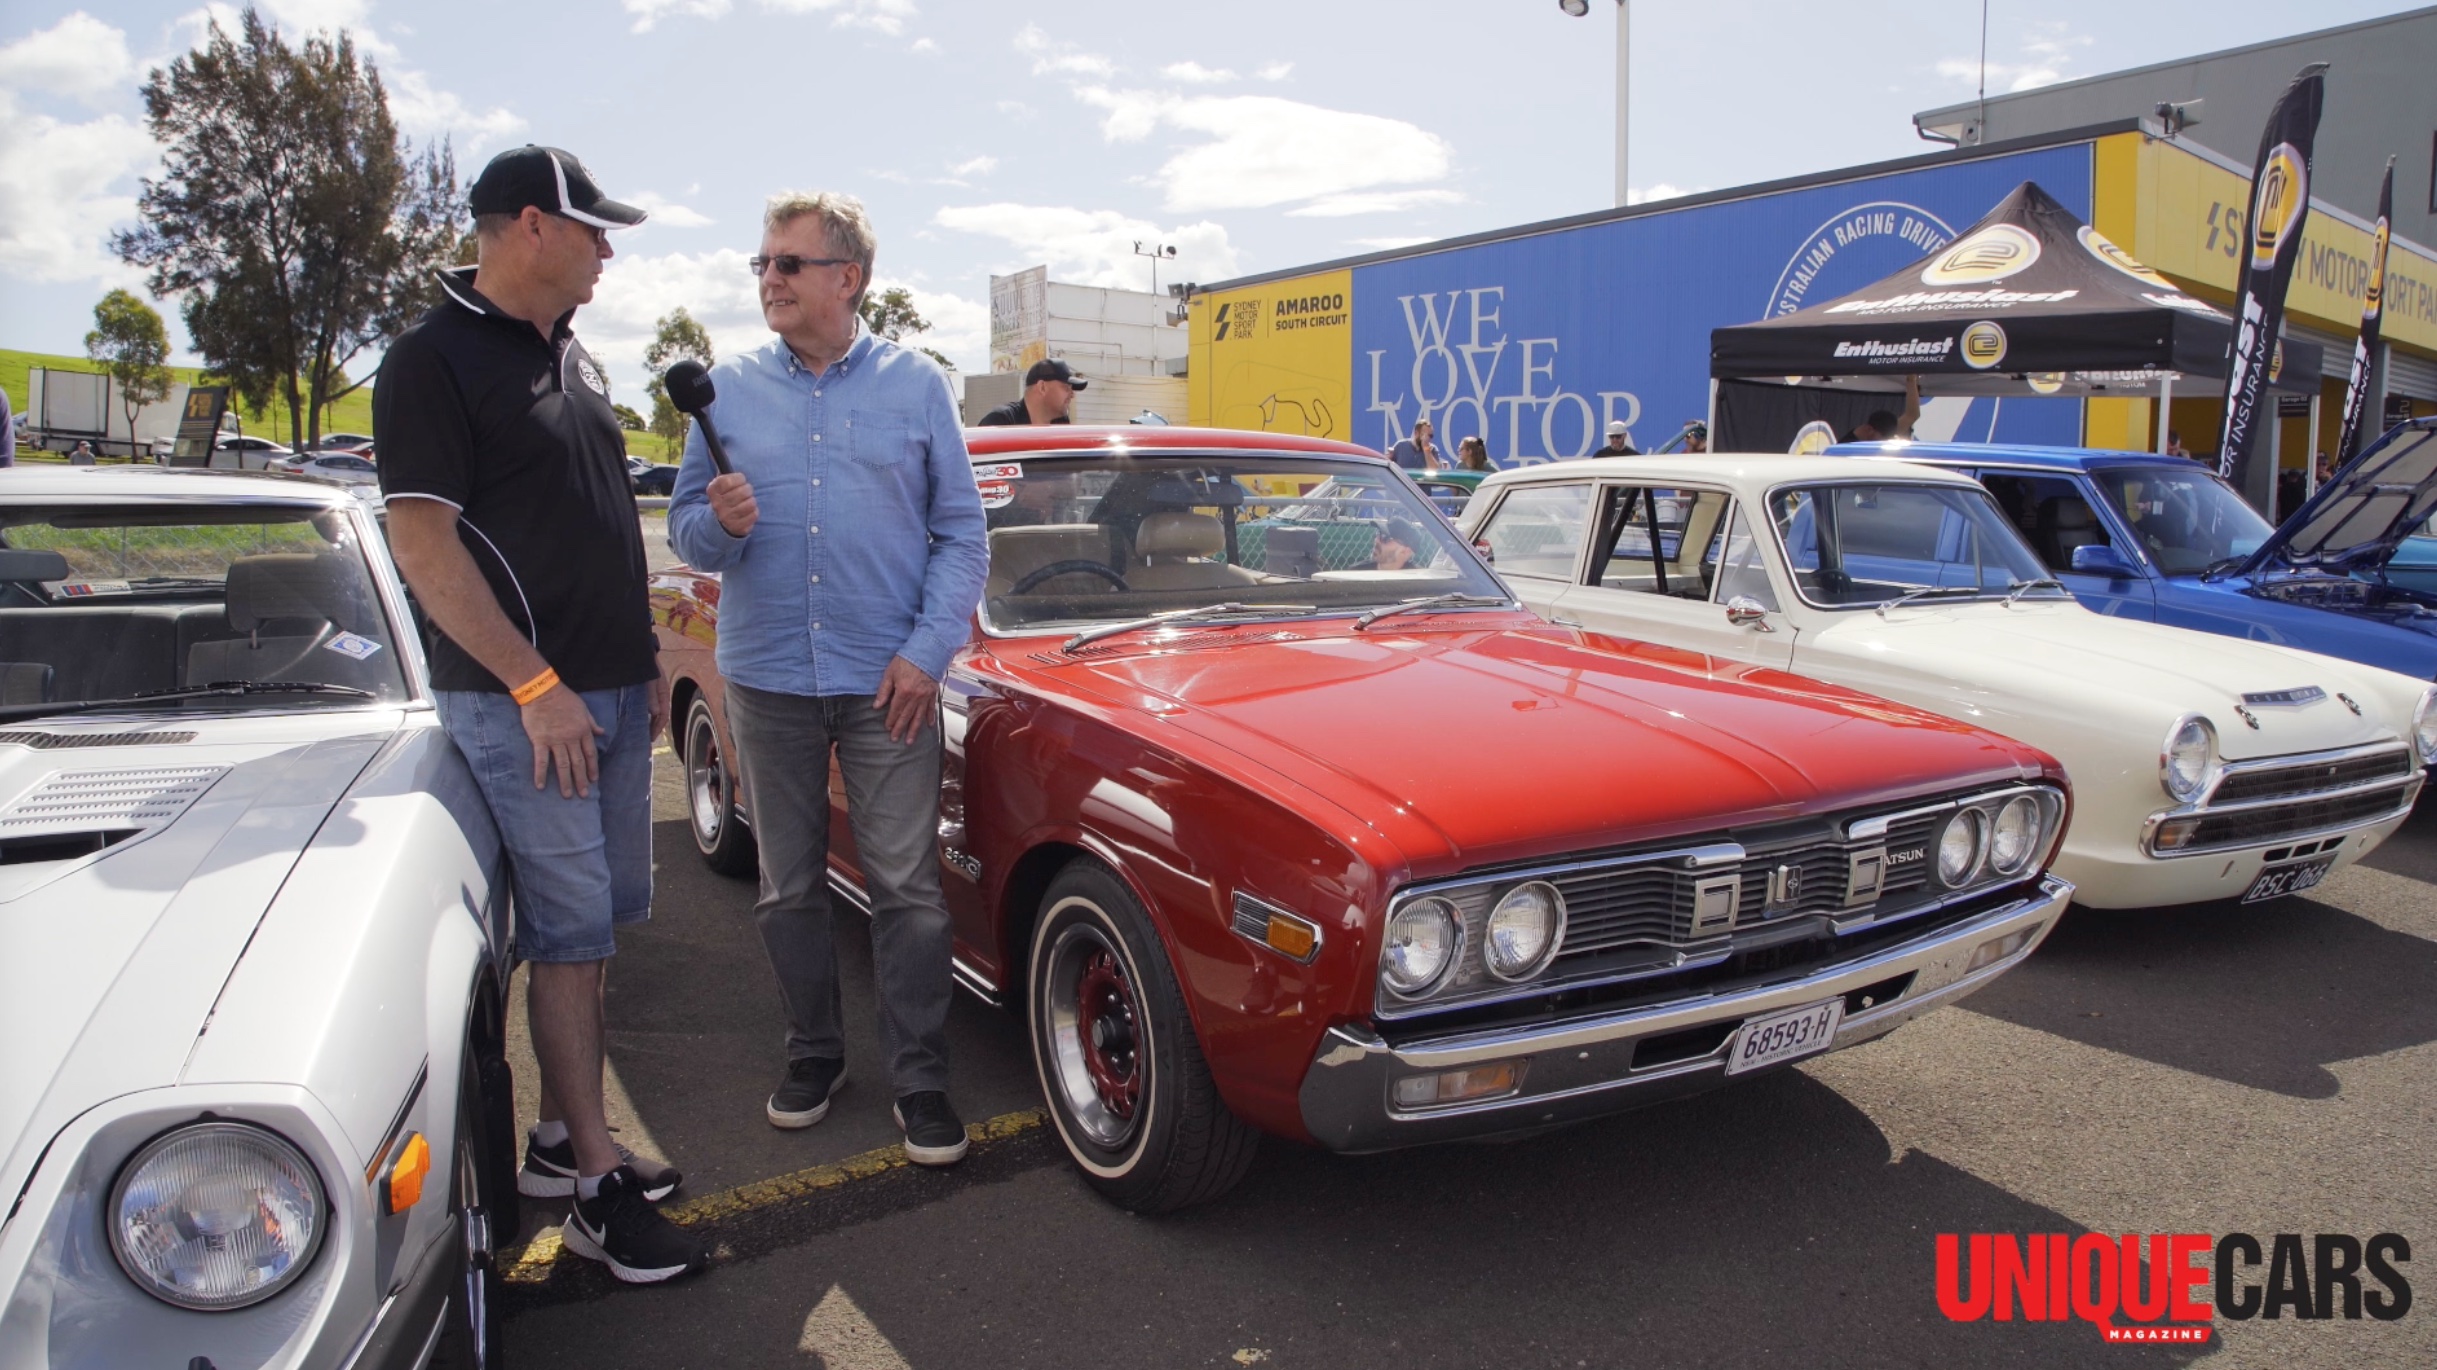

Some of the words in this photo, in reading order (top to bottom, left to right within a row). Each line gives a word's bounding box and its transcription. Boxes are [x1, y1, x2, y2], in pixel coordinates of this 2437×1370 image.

[1777, 239, 1835, 317] STRALIAN
[1834, 213, 1895, 247] RACING
[1899, 217, 1949, 255] DRIVE
[1233, 300, 1261, 311] SYDNEY
[1276, 294, 1343, 316] AMAROO
[1823, 289, 2079, 314] Enthusiast
[1856, 306, 1910, 315] MOTOR
[1917, 302, 2017, 312] INSURANCE
[1233, 310, 1258, 320] MOTOR
[1276, 318, 1307, 331] SOUTH
[1310, 314, 1347, 327] CIRCUIT
[1398, 286, 1507, 357] WE
[1233, 319, 1256, 330] SPORT
[1233, 330, 1253, 340] PARK
[1833, 337, 1954, 357] Enthusiast
[1868, 357, 1899, 365] MOTOR
[1899, 355, 1947, 364] INSURANCE
[1366, 337, 1562, 412] LOVE
